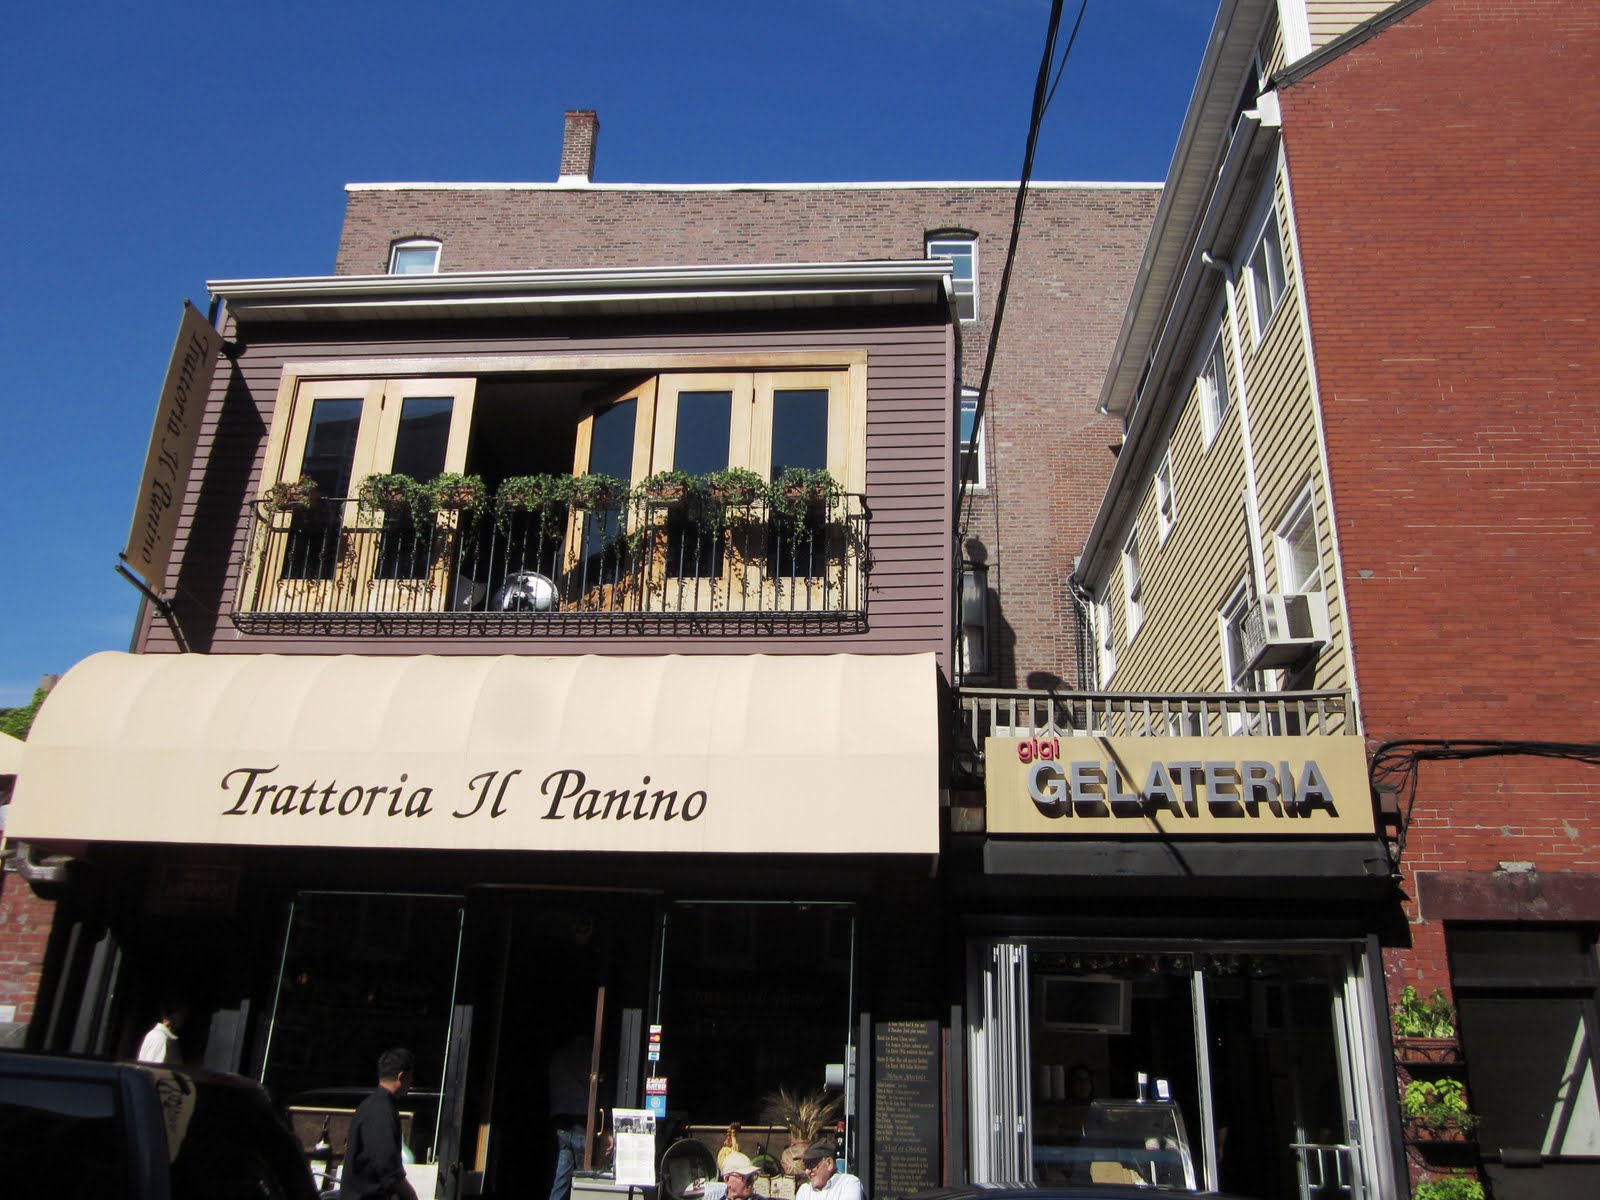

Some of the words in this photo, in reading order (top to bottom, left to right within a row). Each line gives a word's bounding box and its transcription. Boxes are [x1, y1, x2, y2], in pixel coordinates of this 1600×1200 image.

[167, 329, 209, 437] Trattoria
[158, 437, 179, 476] Il
[142, 475, 173, 564] Panino
[1017, 737, 1060, 761] gigi
[220, 763, 434, 818] Trattoria
[452, 768, 523, 819] Il
[540, 768, 709, 822] Panino
[1027, 759, 1334, 804] GELATERIA
